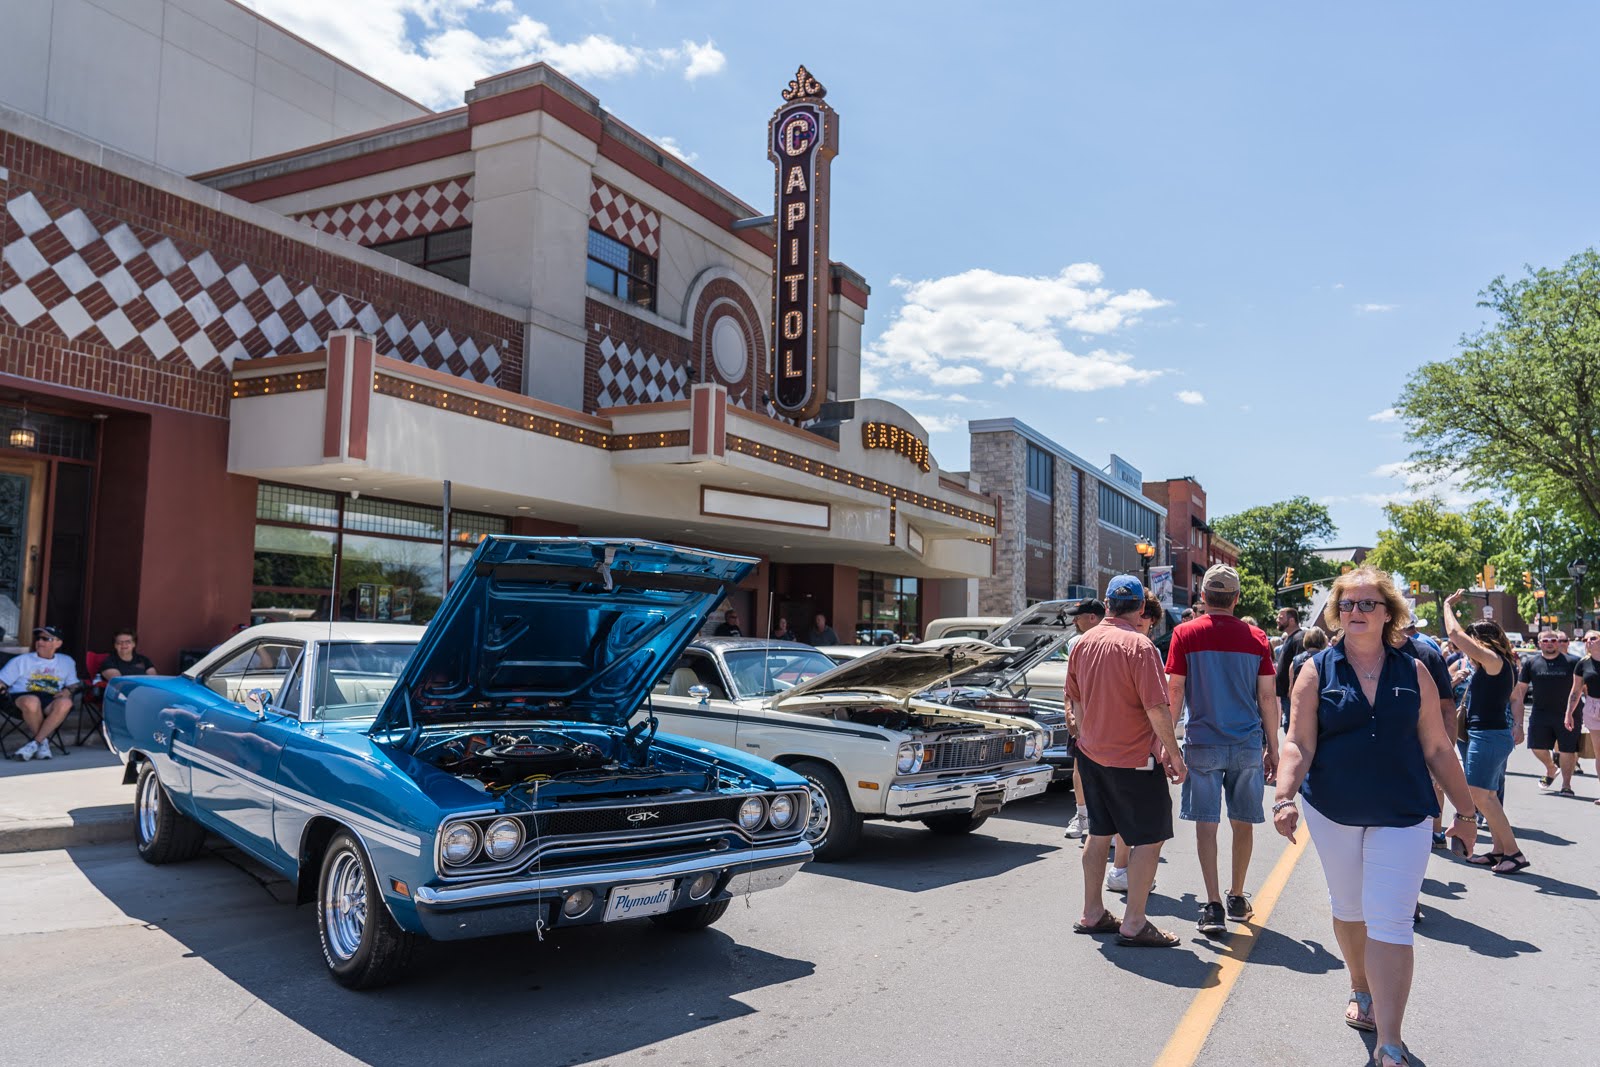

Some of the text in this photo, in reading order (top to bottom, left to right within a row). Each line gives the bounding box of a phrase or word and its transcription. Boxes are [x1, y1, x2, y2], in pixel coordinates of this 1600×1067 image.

[784, 119, 808, 378] CAPITOL
[866, 422, 931, 472] CAPITOL
[627, 811, 660, 822] GTX
[615, 889, 673, 915] Plymouth
